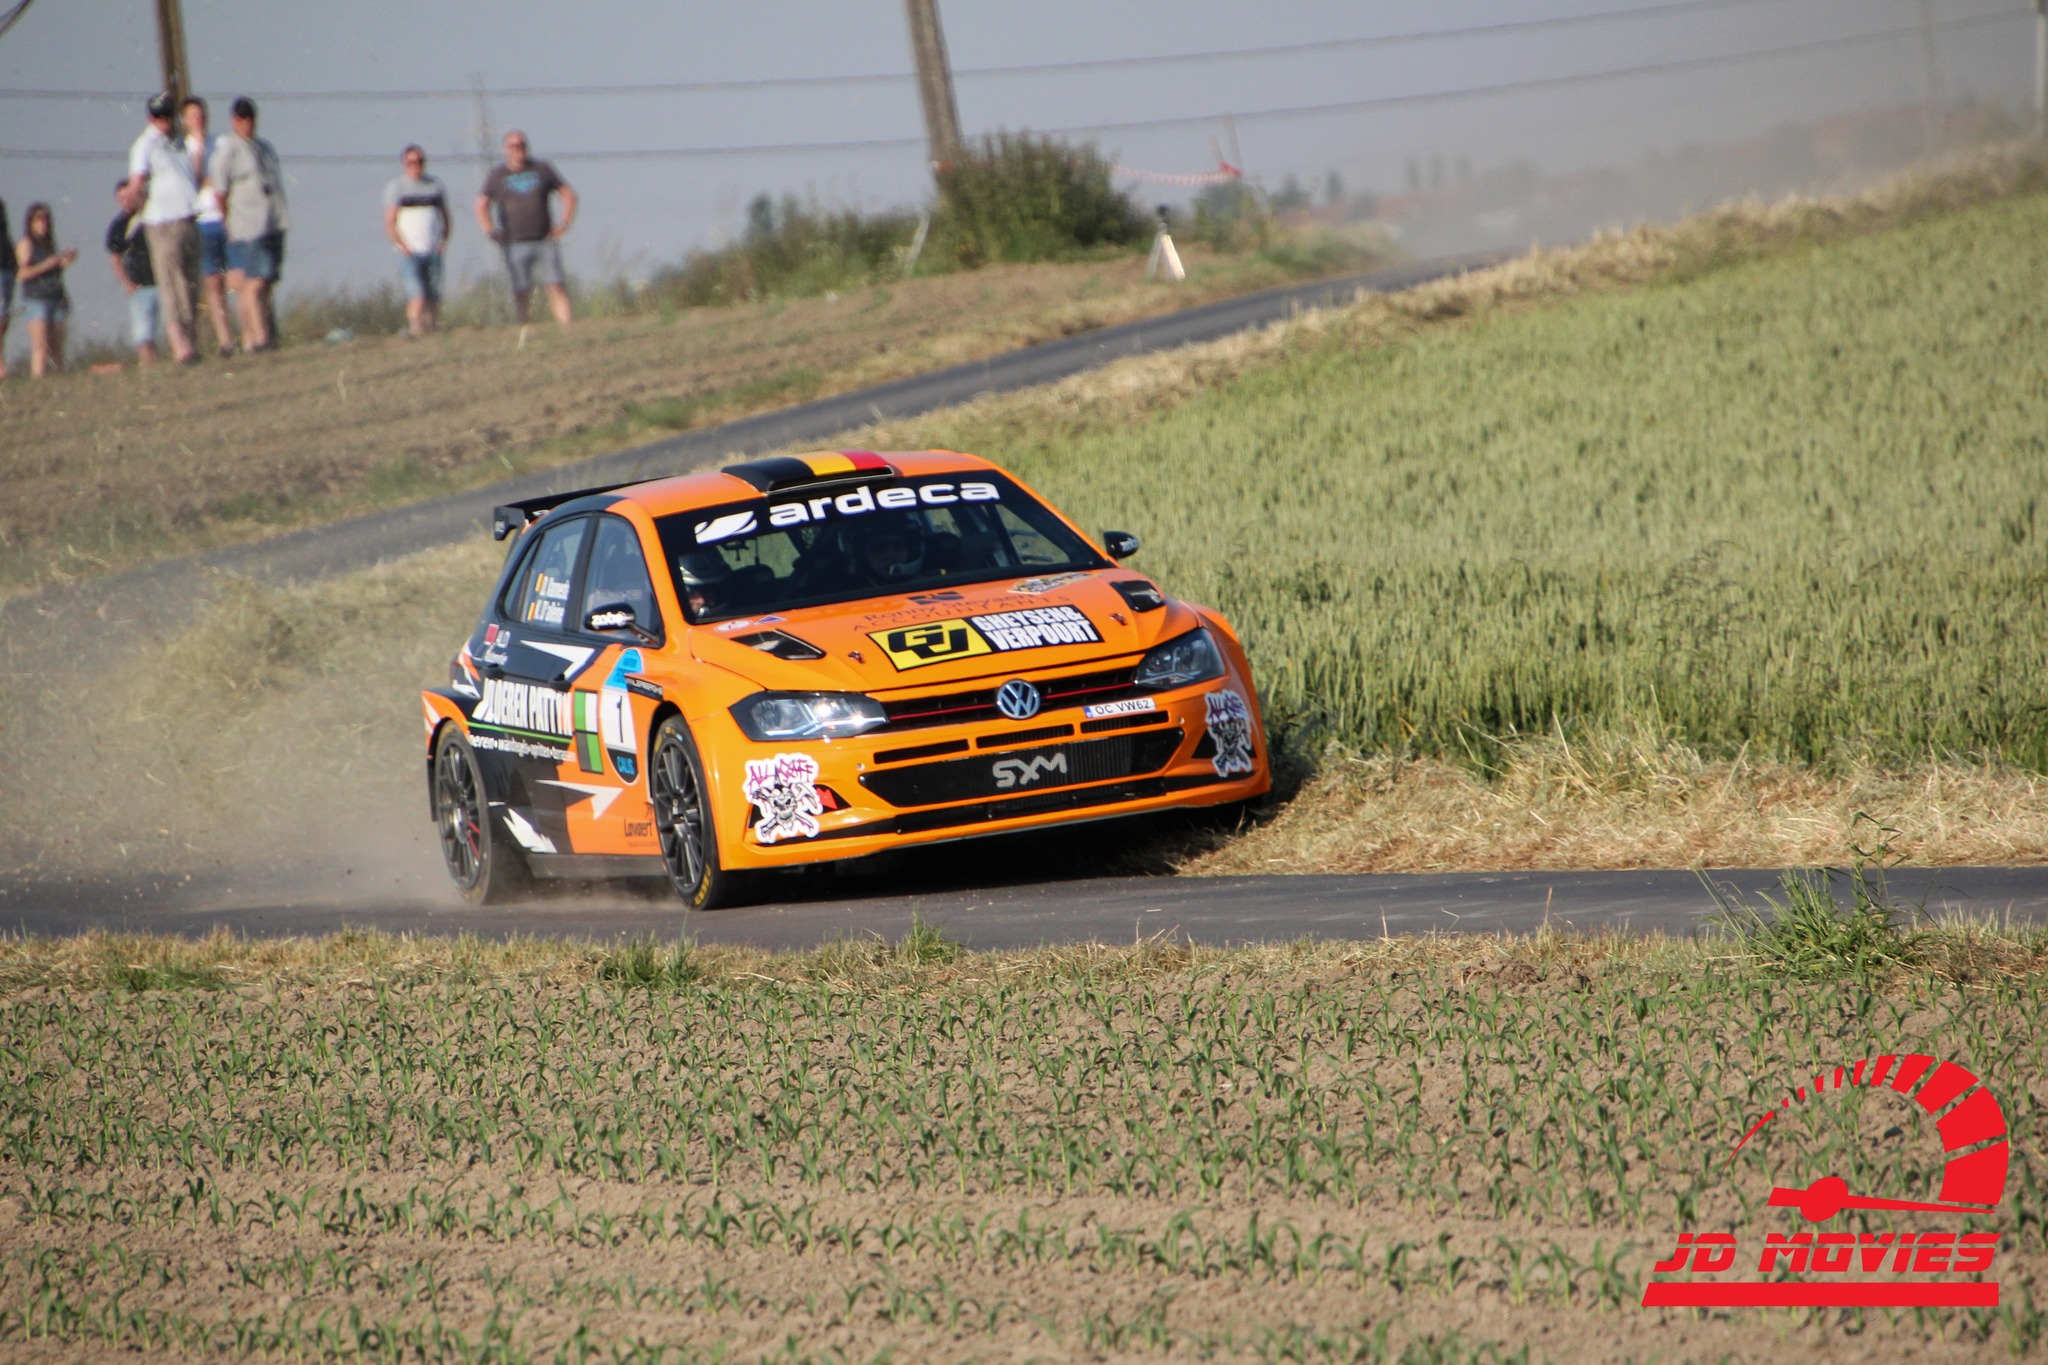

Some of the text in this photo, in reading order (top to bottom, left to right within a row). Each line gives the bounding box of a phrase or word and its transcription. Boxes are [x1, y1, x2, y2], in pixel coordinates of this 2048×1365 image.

[769, 482, 1000, 527] ardeca
[984, 620, 1099, 651] VERPOORT
[616, 695, 624, 743] 1
[1094, 699, 1151, 714] OC VW62
[992, 752, 1068, 789] SXM
